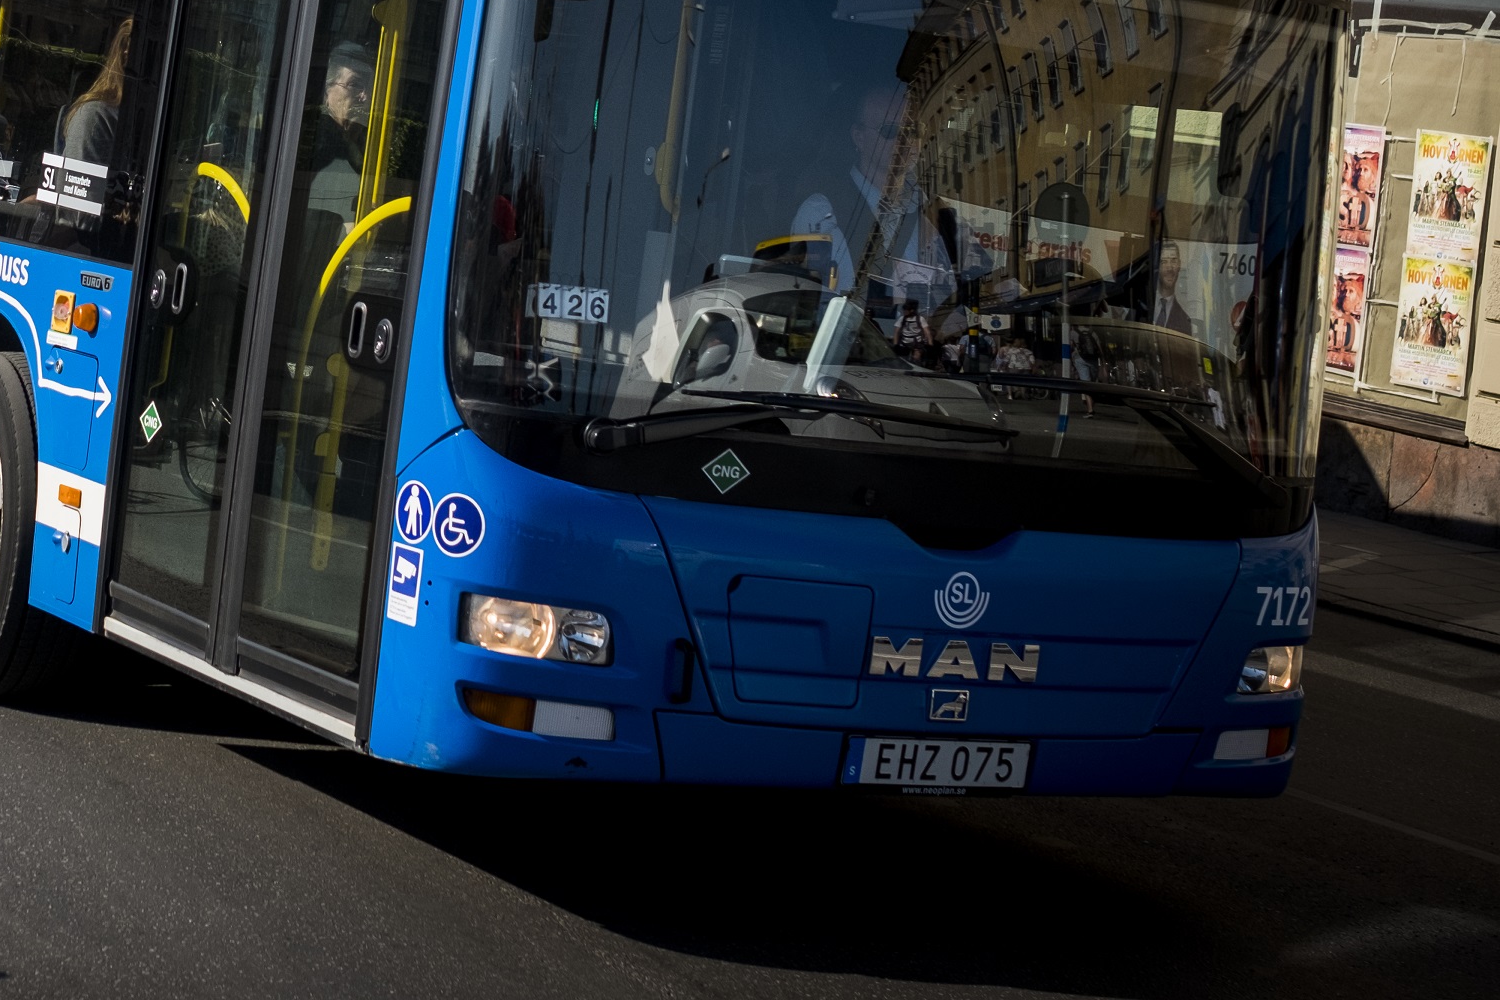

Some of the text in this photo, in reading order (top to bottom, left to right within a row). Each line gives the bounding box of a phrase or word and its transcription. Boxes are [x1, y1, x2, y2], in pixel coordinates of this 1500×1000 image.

[42, 167, 56, 190] SL
[82, 275, 111, 290] EURO 6
[144, 414, 158, 430] CNG
[711, 464, 741, 479] CNG
[950, 582, 974, 604] SL
[1256, 586, 1311, 626] 7172
[868, 635, 1041, 683] MAN
[874, 743, 942, 782] EHZ
[950, 745, 1016, 783] 075
[902, 786, 967, 797] www.neoplan.se
